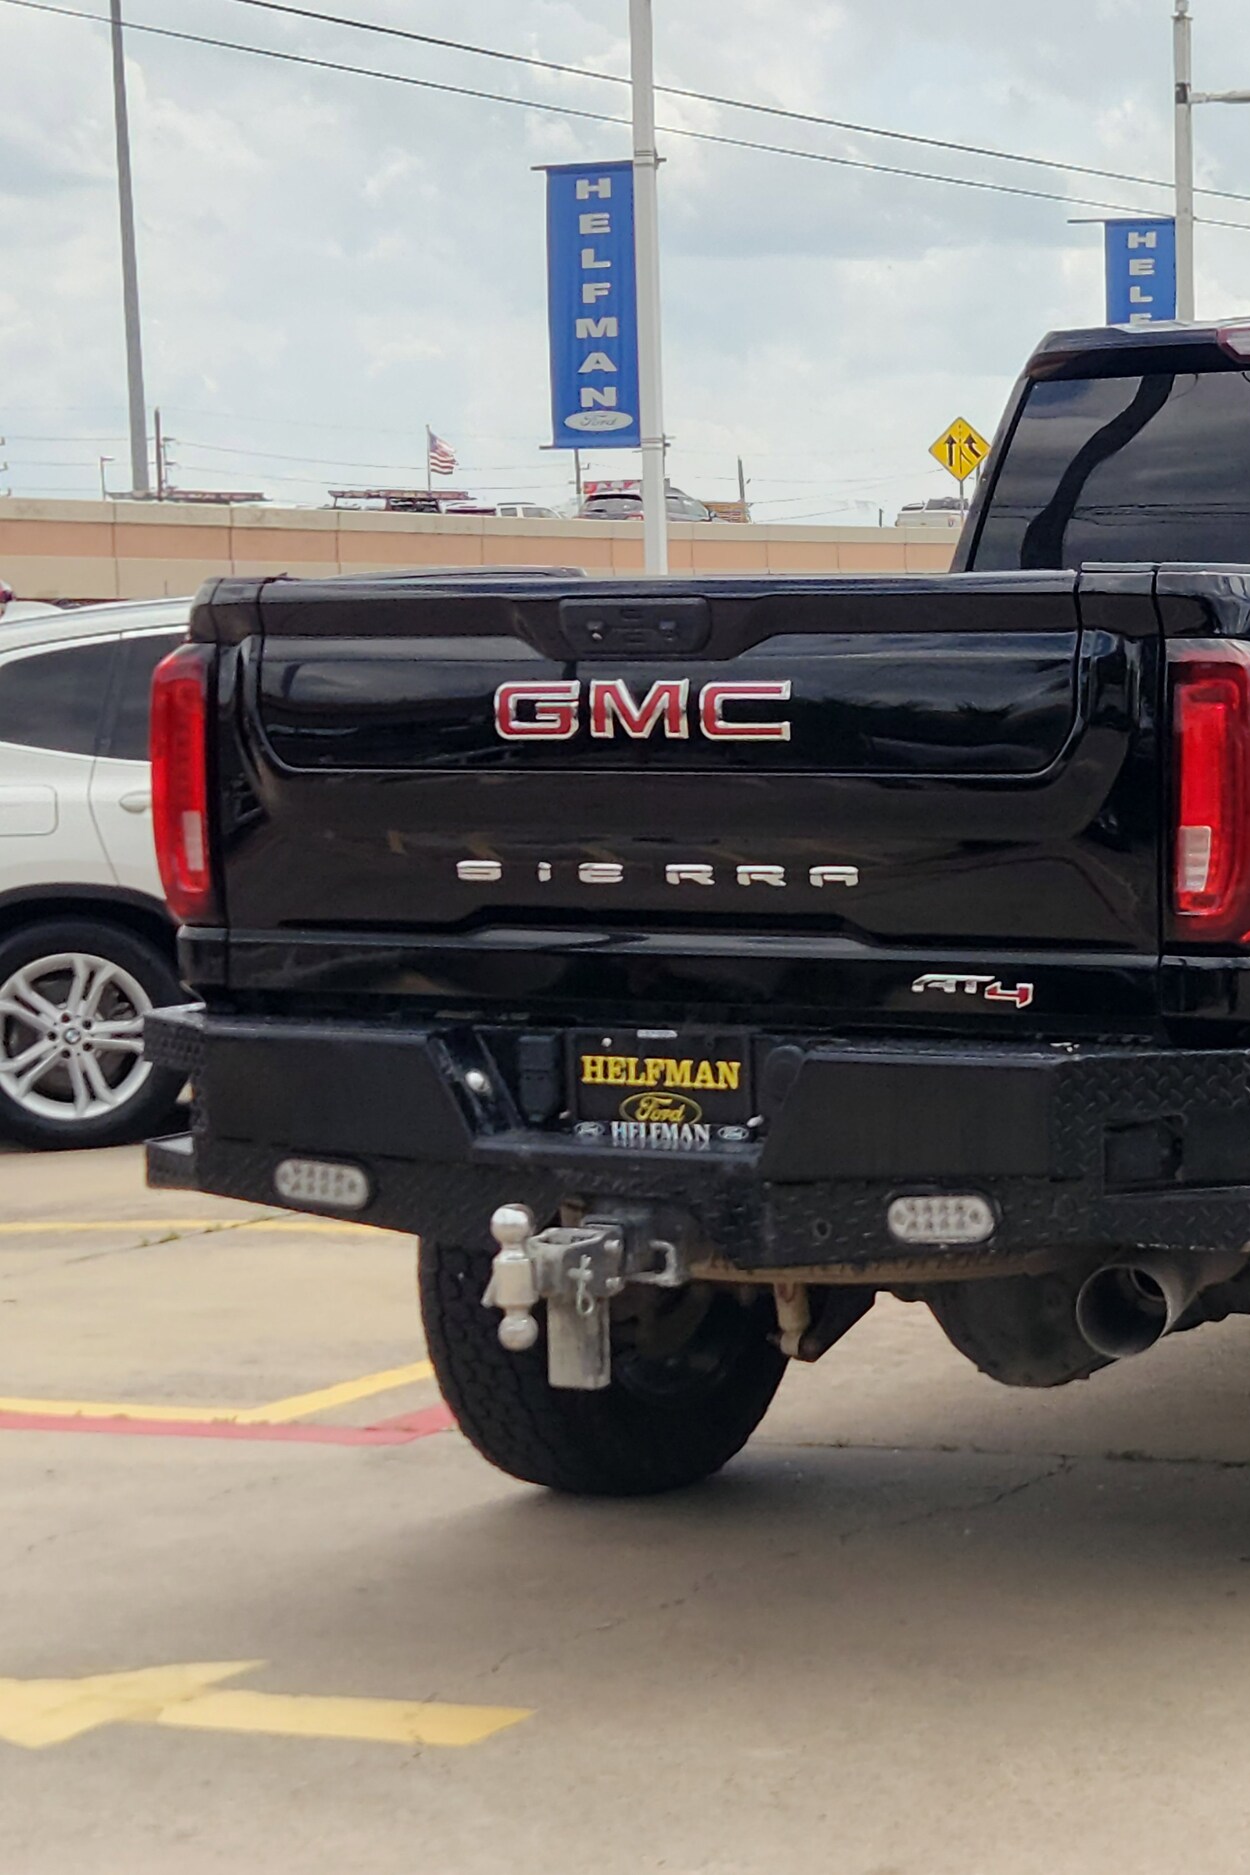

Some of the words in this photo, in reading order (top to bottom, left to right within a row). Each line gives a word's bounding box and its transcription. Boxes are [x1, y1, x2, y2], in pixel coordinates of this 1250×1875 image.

[575, 177, 618, 408] HELFMAN
[494, 678, 792, 741] GMC
[911, 973, 1034, 1009] AT4
[578, 1054, 742, 1090] HELFMAN
[635, 1096, 686, 1123] Ford
